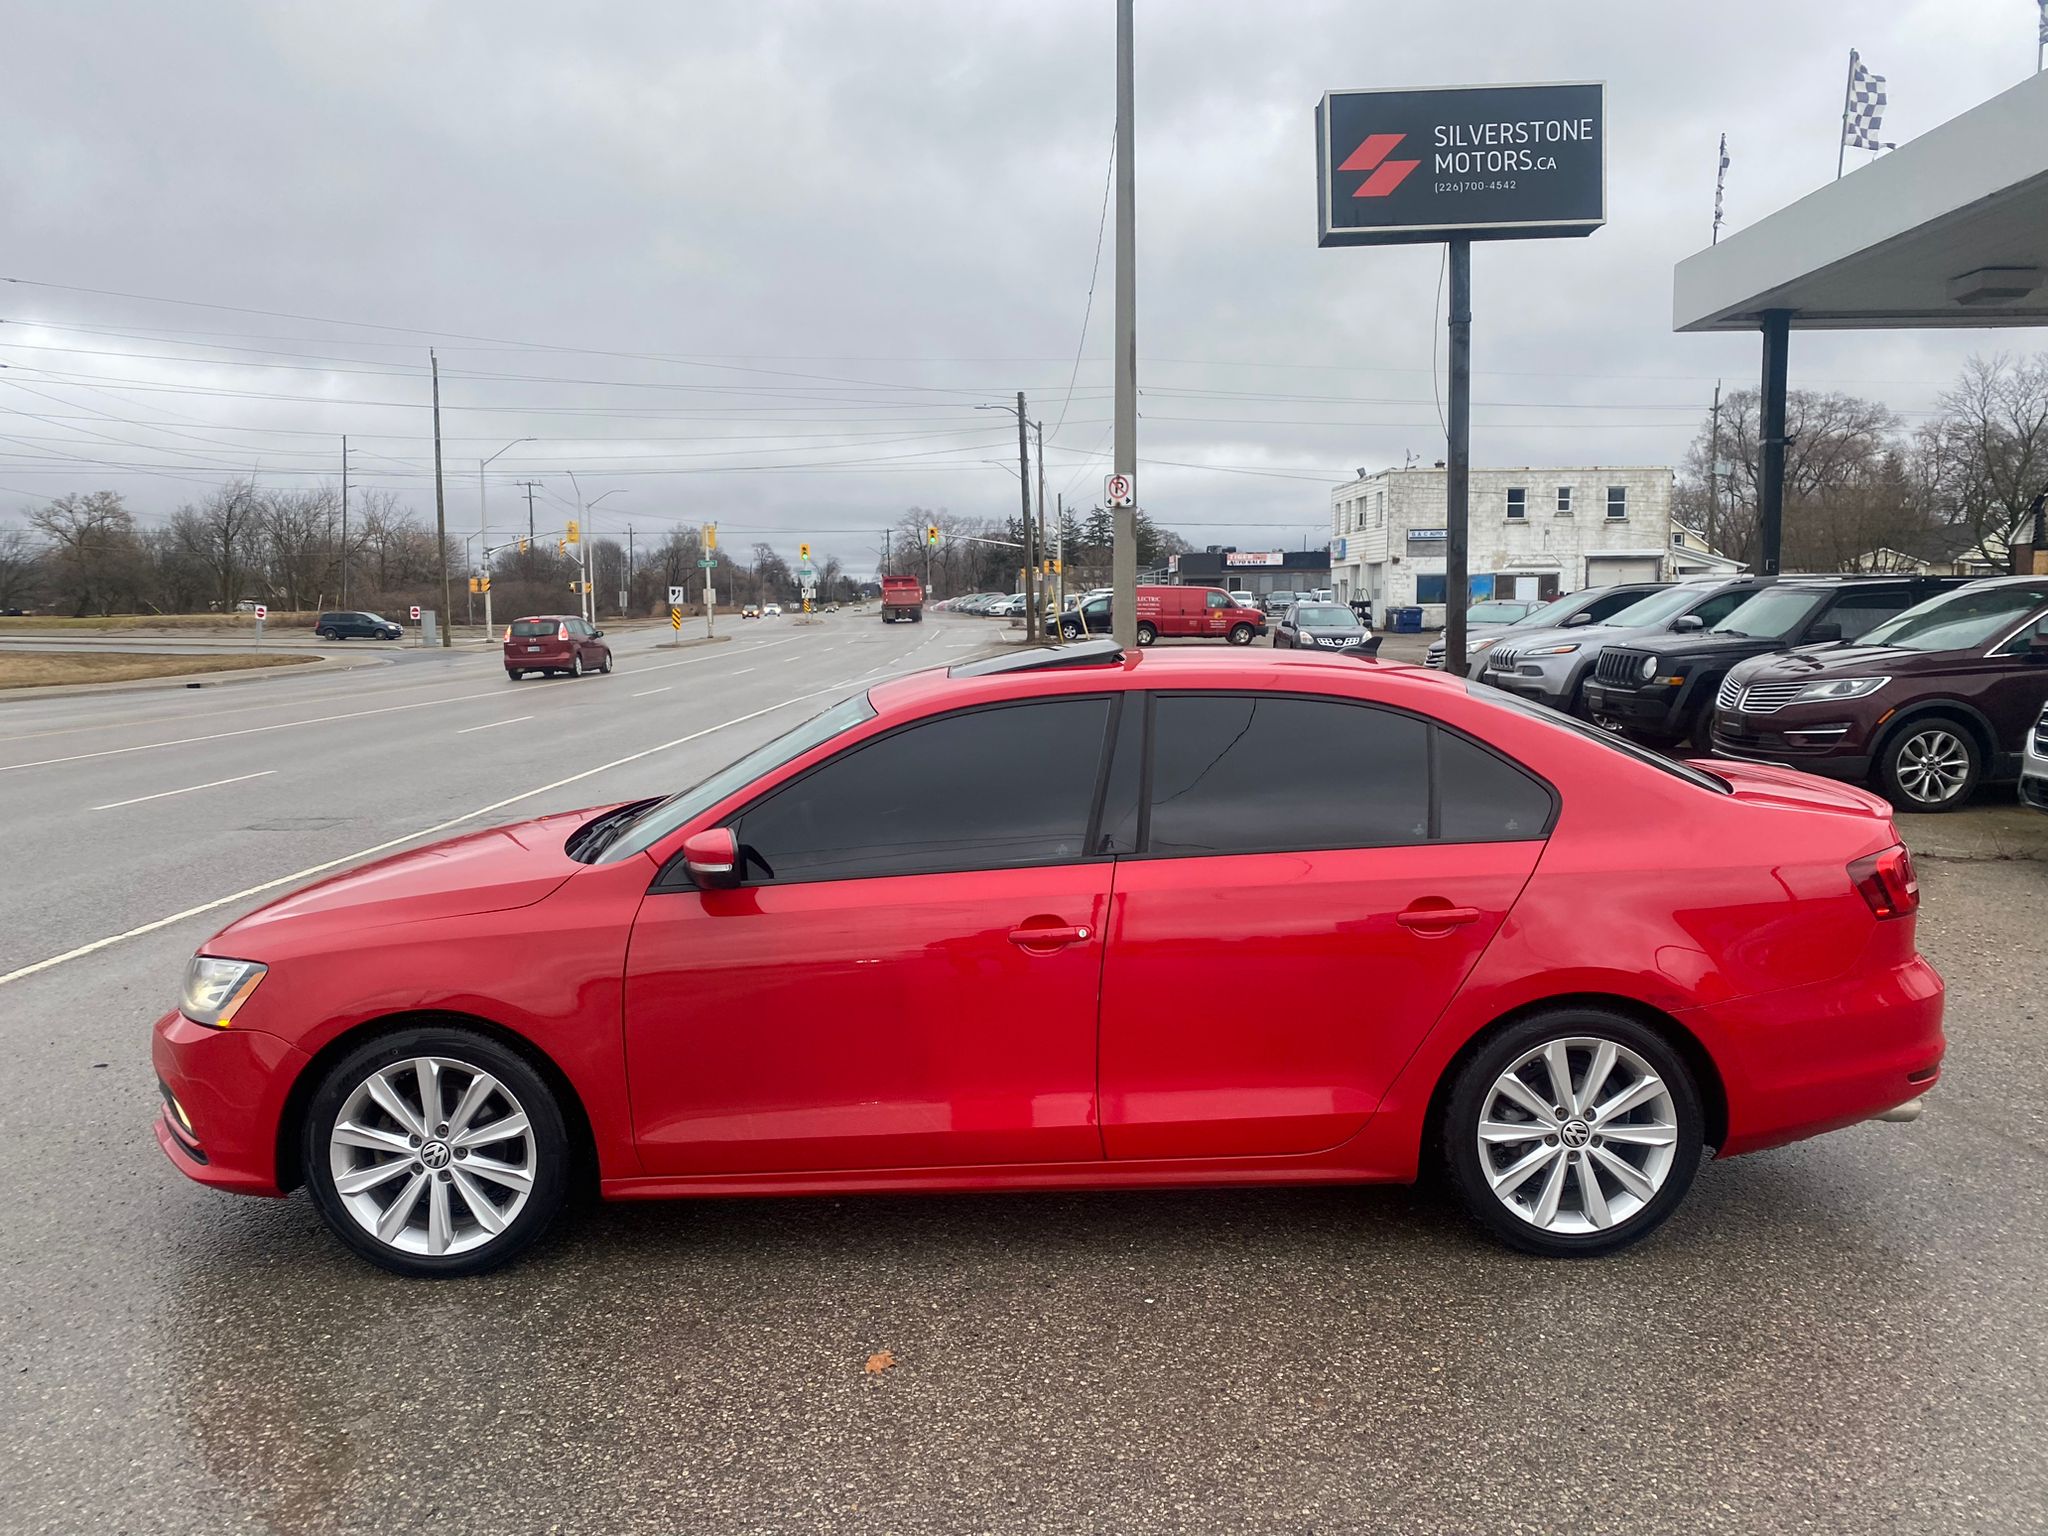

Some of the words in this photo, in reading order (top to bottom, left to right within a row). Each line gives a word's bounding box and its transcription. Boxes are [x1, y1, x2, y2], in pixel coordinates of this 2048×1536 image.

[1434, 118, 1593, 147] SILVERSTONE
[1434, 150, 1557, 174] MOTORS.CA
[1434, 180, 1517, 193] (226)700-4542
